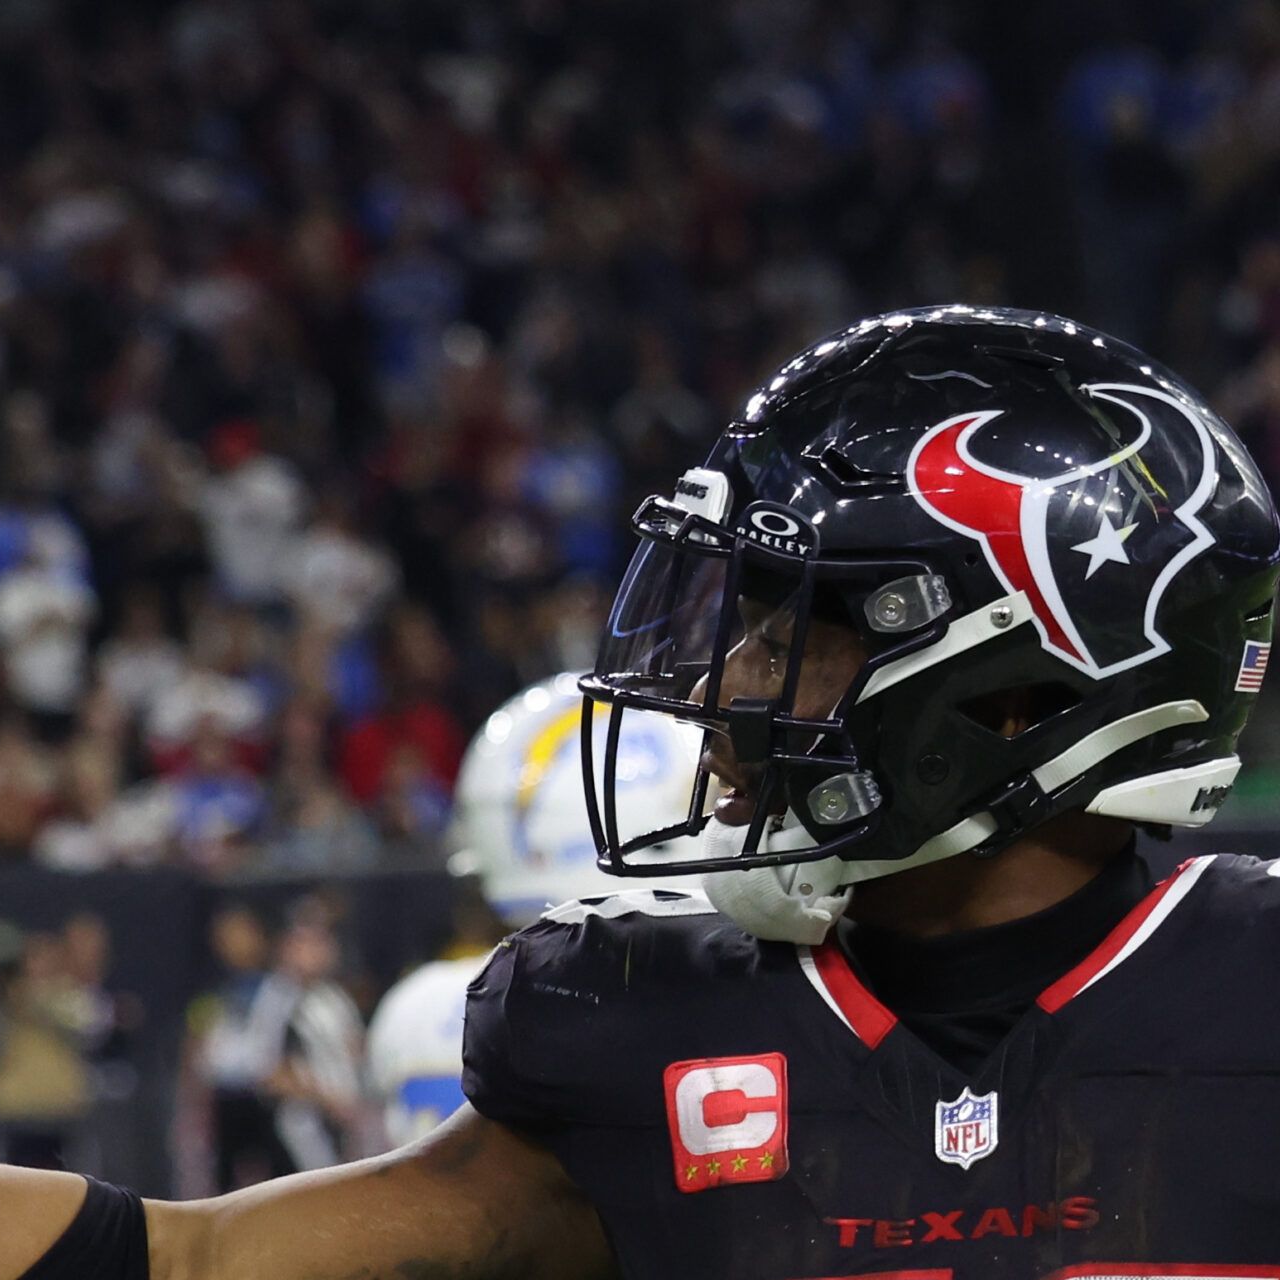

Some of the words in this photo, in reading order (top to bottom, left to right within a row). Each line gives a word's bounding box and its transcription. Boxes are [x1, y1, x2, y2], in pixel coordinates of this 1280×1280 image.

[675, 1063, 778, 1156] C
[945, 1121, 987, 1153] NFL
[825, 1195, 1101, 1249] TEXANS
